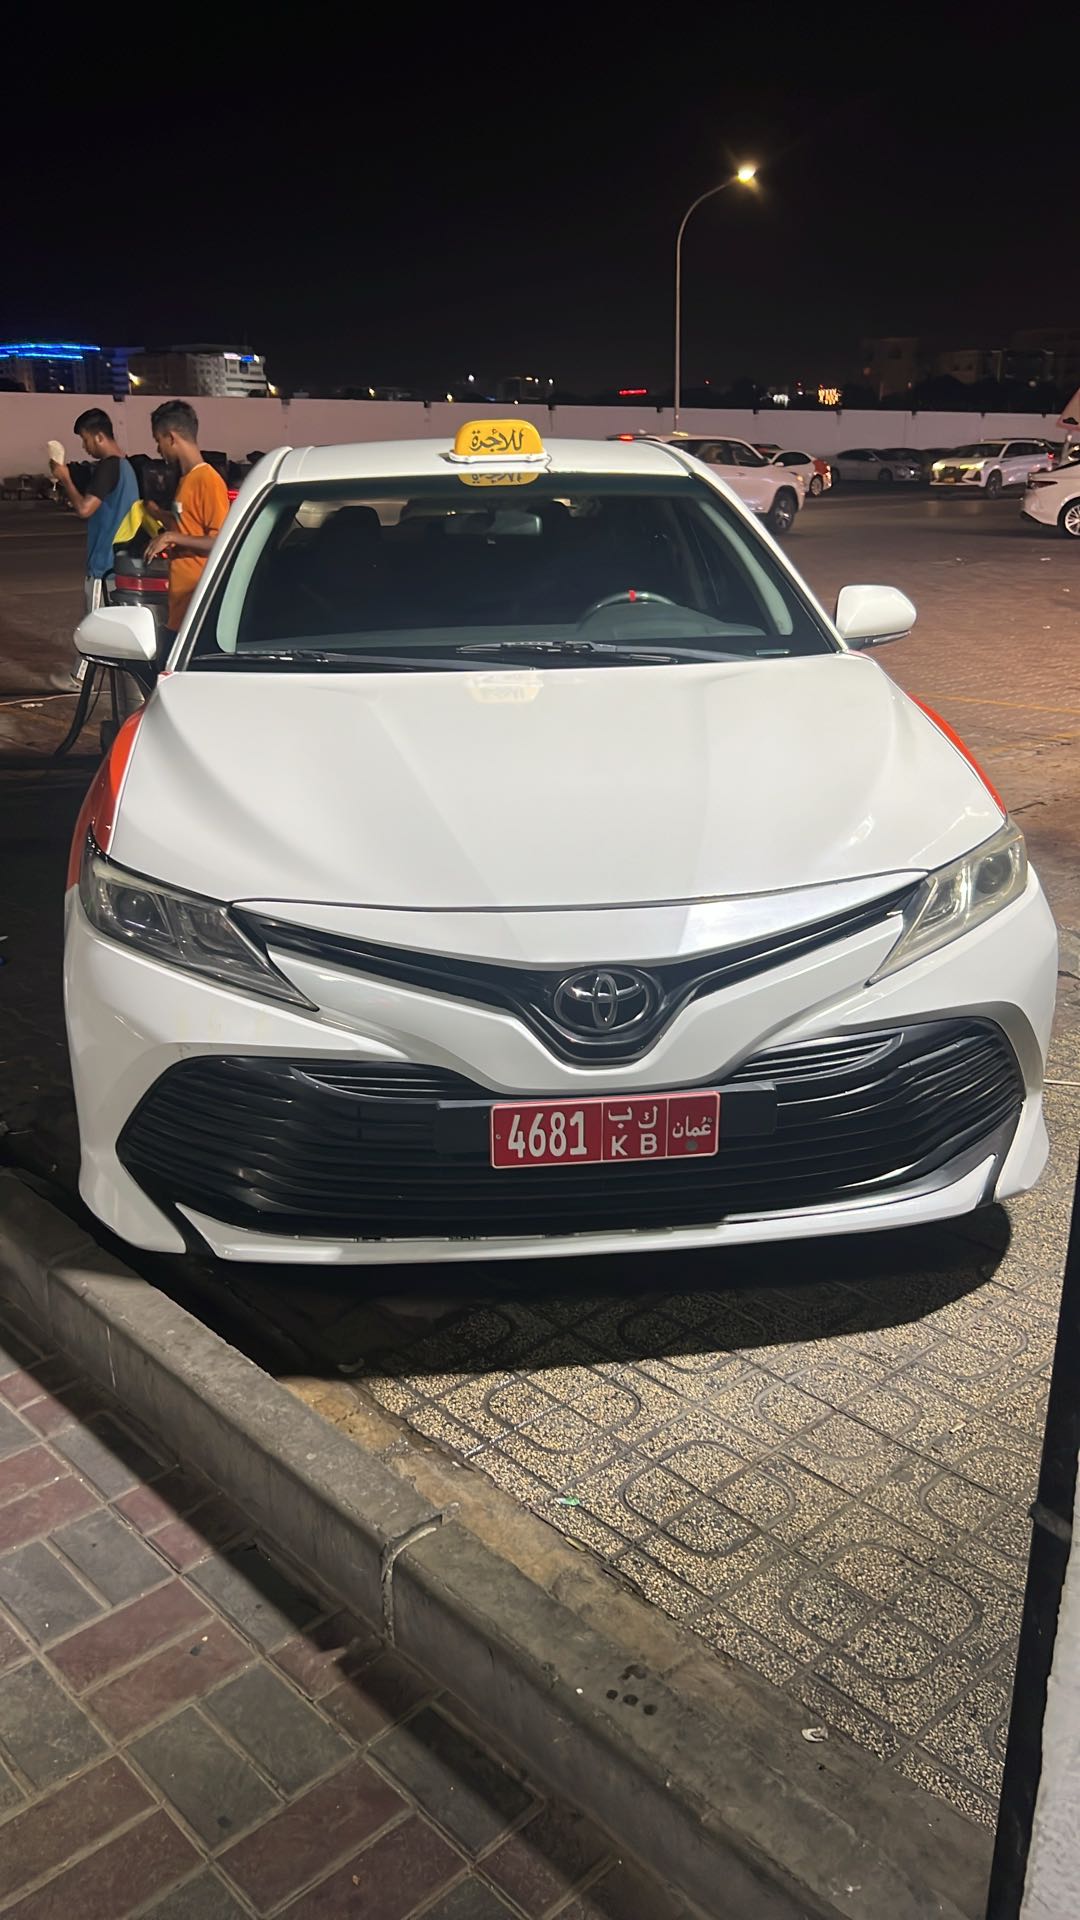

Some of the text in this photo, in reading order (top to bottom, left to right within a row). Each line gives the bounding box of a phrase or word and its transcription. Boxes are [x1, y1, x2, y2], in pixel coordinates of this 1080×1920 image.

[608, 1105, 658, 1129] ك ب
[508, 1111, 587, 1158] 4681
[611, 1133, 657, 1157] K B
